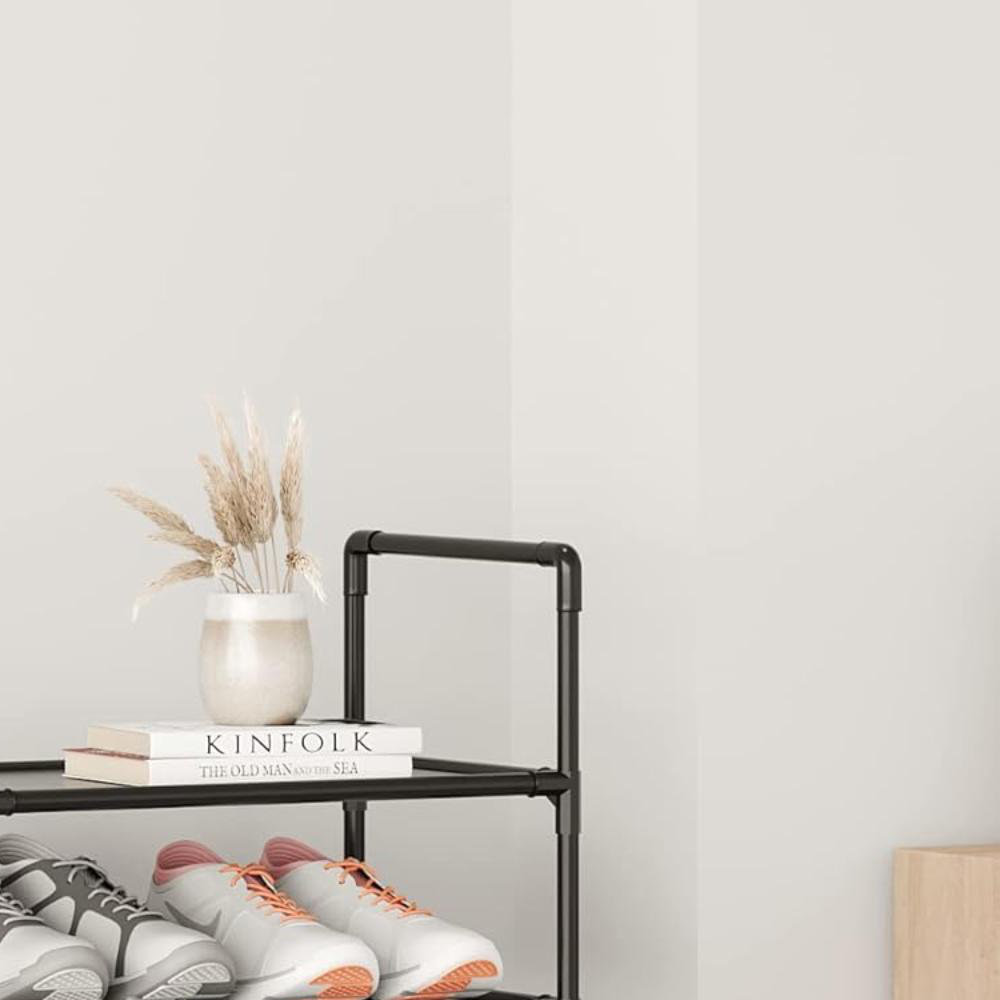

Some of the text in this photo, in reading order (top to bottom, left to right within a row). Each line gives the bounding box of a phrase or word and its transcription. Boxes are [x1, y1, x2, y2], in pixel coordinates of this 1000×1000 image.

[206, 731, 373, 755] KINFOLK
[199, 765, 228, 778] THE
[230, 764, 260, 778] OLD
[262, 763, 293, 777] MAN
[333, 761, 359, 775] SEA
